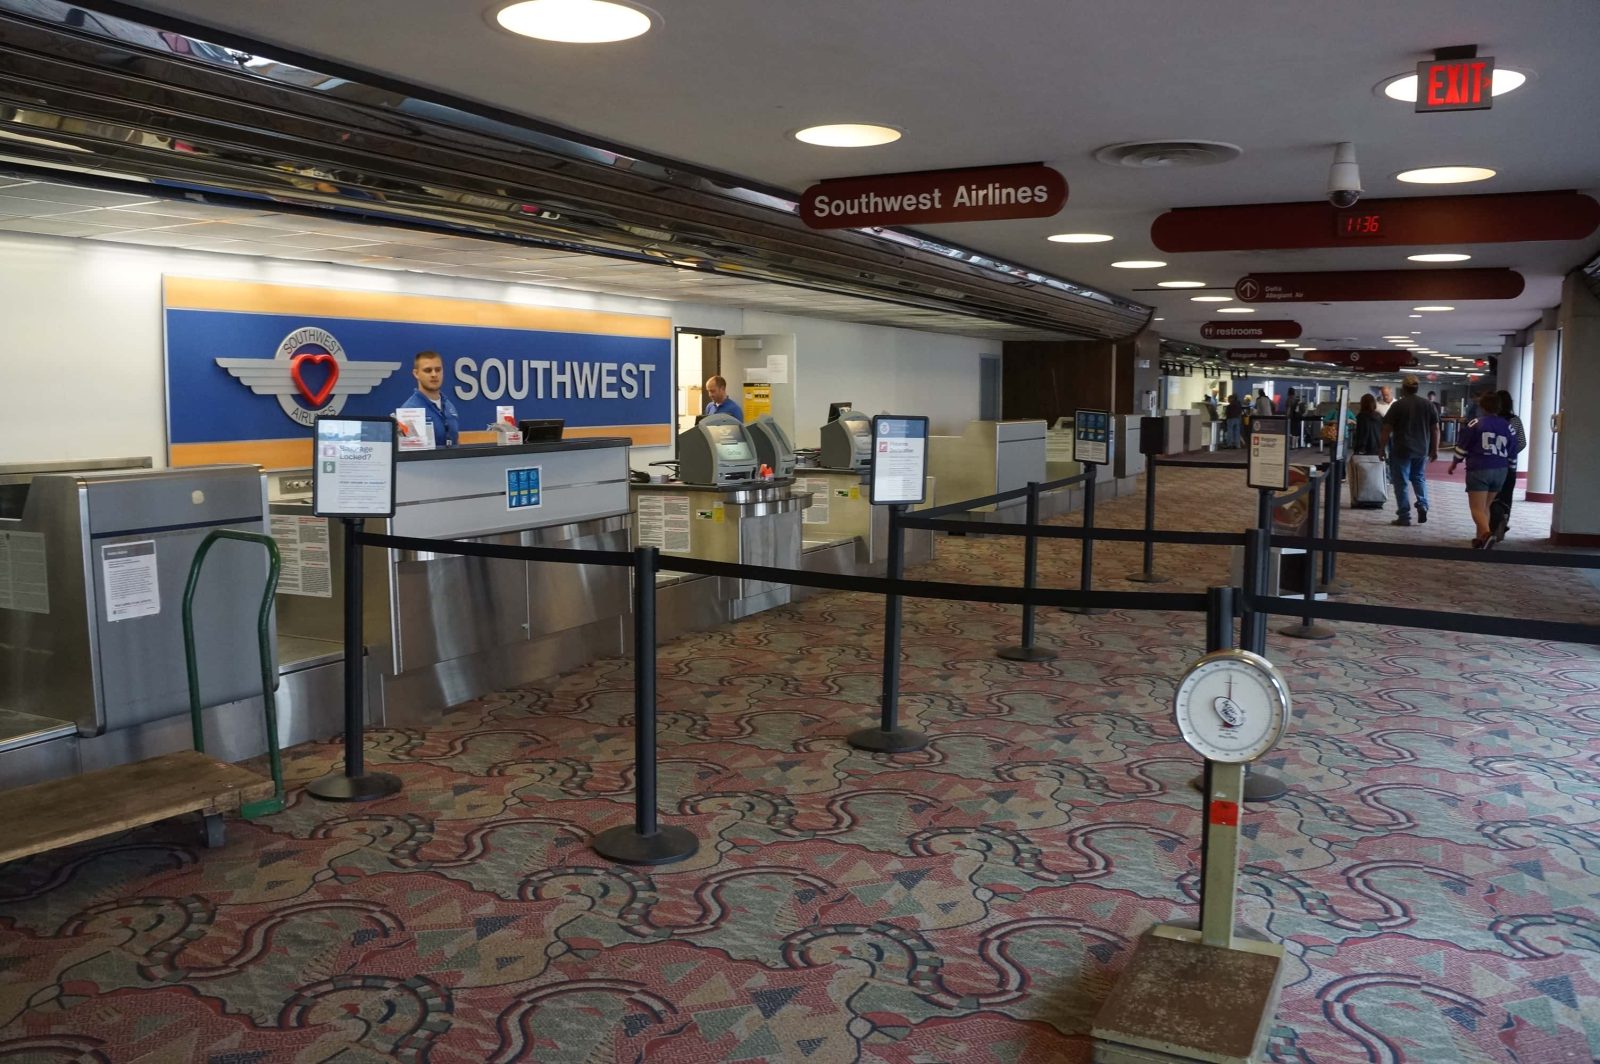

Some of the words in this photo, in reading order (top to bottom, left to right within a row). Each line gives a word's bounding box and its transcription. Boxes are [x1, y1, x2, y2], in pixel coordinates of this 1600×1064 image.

[1427, 62, 1486, 107] EXIT
[813, 188, 942, 217] Southwest
[953, 183, 1049, 208] Airlines
[283, 329, 341, 354] SOUTHWEST
[1216, 327, 1263, 336] restrooms
[454, 357, 656, 400] SOUTHWEST
[291, 405, 336, 424] AIRLS
[1482, 431, 1508, 458] 50
